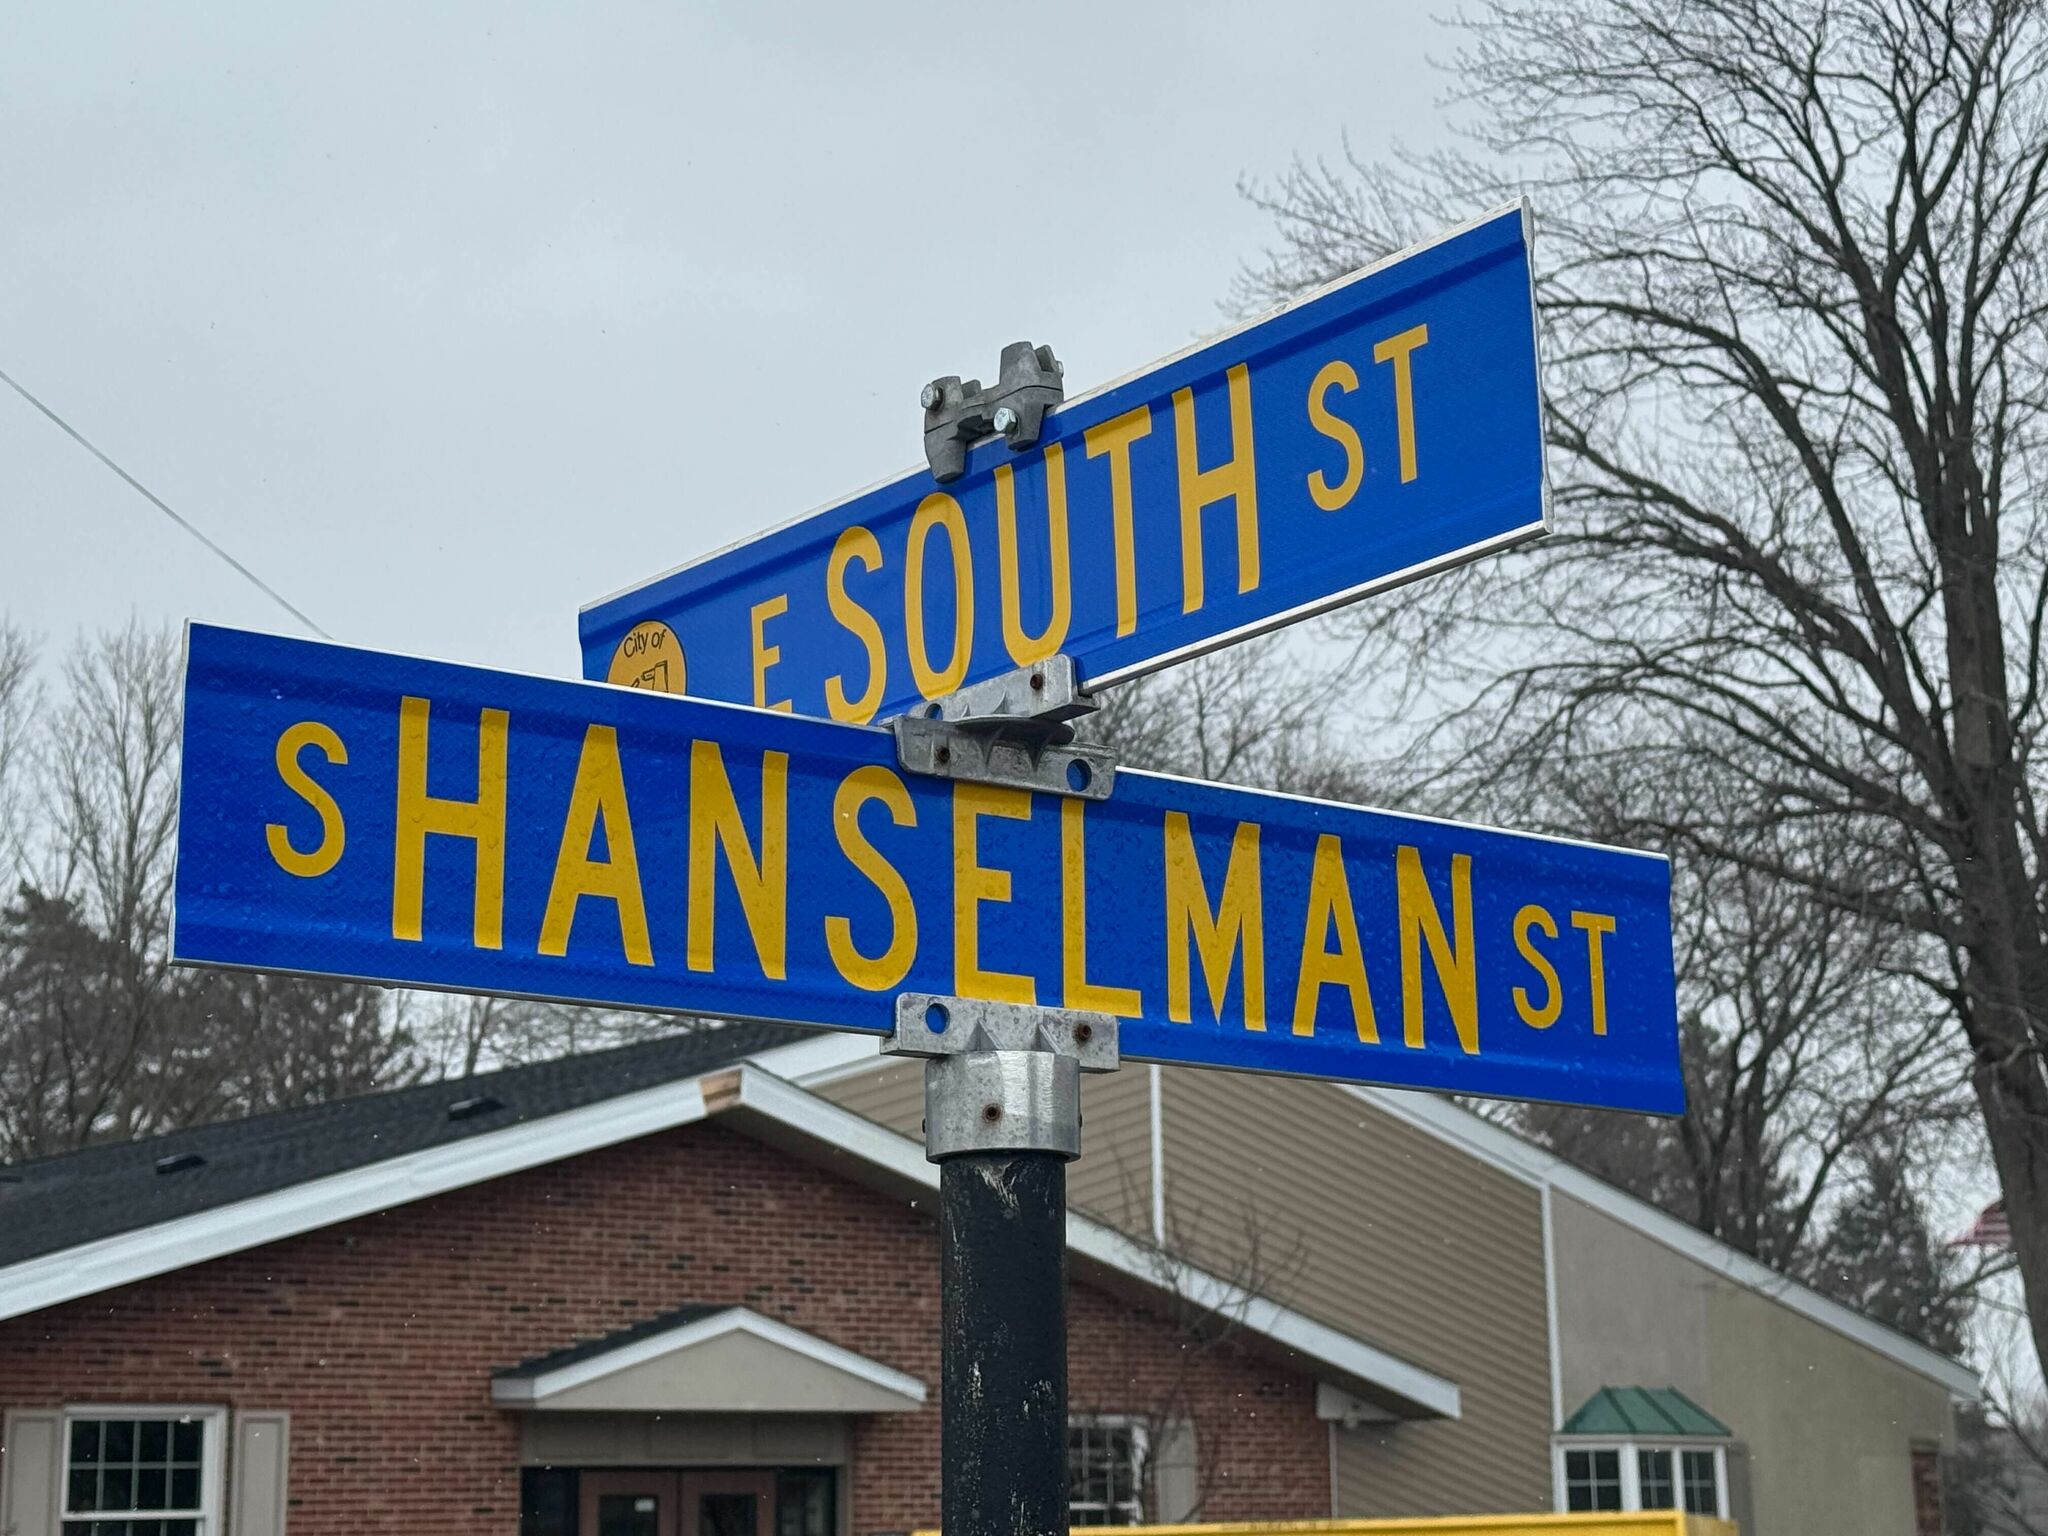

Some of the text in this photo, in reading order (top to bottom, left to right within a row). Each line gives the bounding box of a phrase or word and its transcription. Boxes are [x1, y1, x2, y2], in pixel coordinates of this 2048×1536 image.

[623, 628, 668, 658] City of
[751, 324, 1430, 725] E SOUTH ST
[265, 695, 1617, 1056] S HANSELMAN ST
